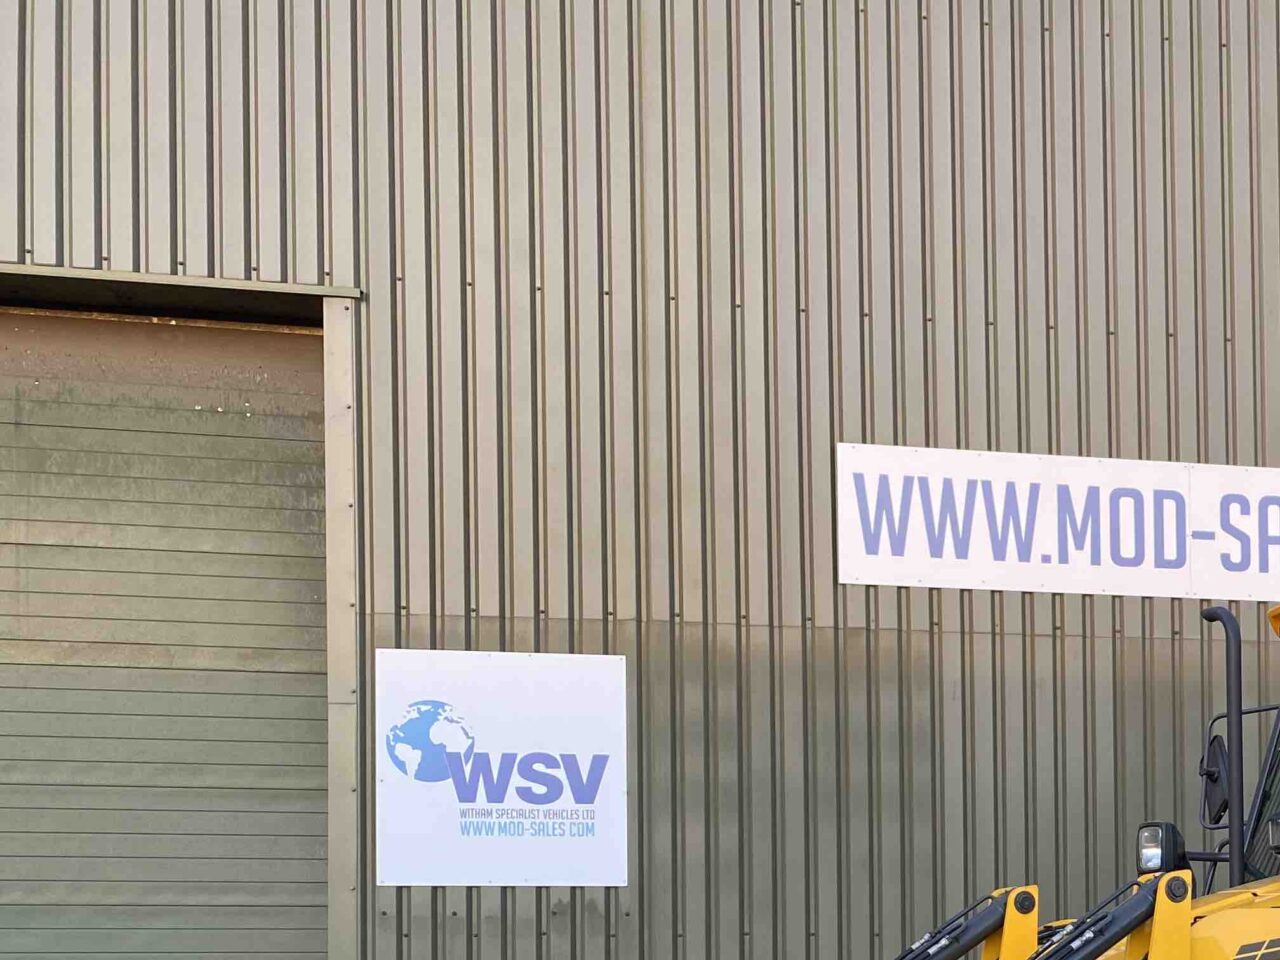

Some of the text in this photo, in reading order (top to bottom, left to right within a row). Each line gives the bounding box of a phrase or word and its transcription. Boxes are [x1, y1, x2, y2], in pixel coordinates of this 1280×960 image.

[445, 751, 610, 806] WSV
[459, 807, 595, 820] WITHAM SPECIALIST VEHICLES LTD
[460, 820, 595, 837] WWWMOD-SALESCOM
